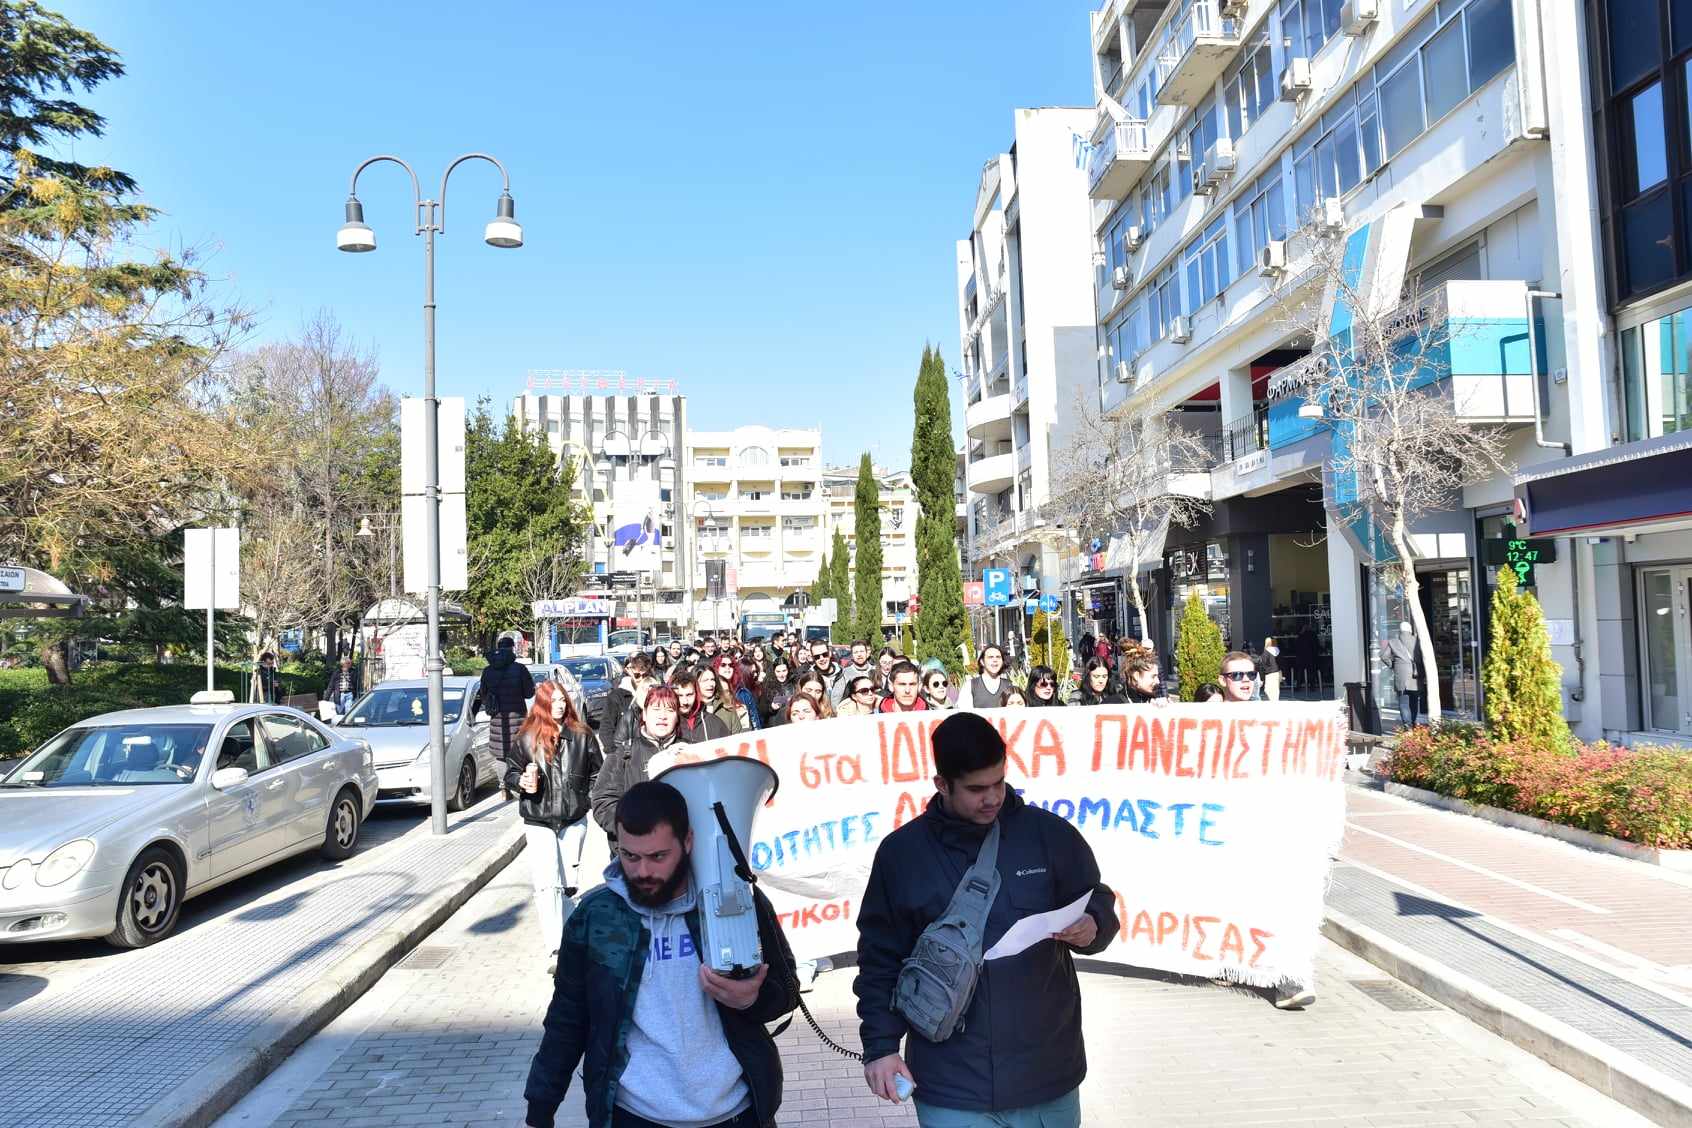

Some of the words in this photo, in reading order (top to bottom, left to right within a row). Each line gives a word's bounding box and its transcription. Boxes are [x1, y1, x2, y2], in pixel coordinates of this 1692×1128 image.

[1506, 550, 1539, 562] 12:47
[989, 571, 1005, 588] P
[1313, 609, 1331, 619] SAL
[877, 717, 1066, 785] ΙΔΙΚΑ
[751, 812, 880, 872] ΟΙΤΗΤΕΣ
